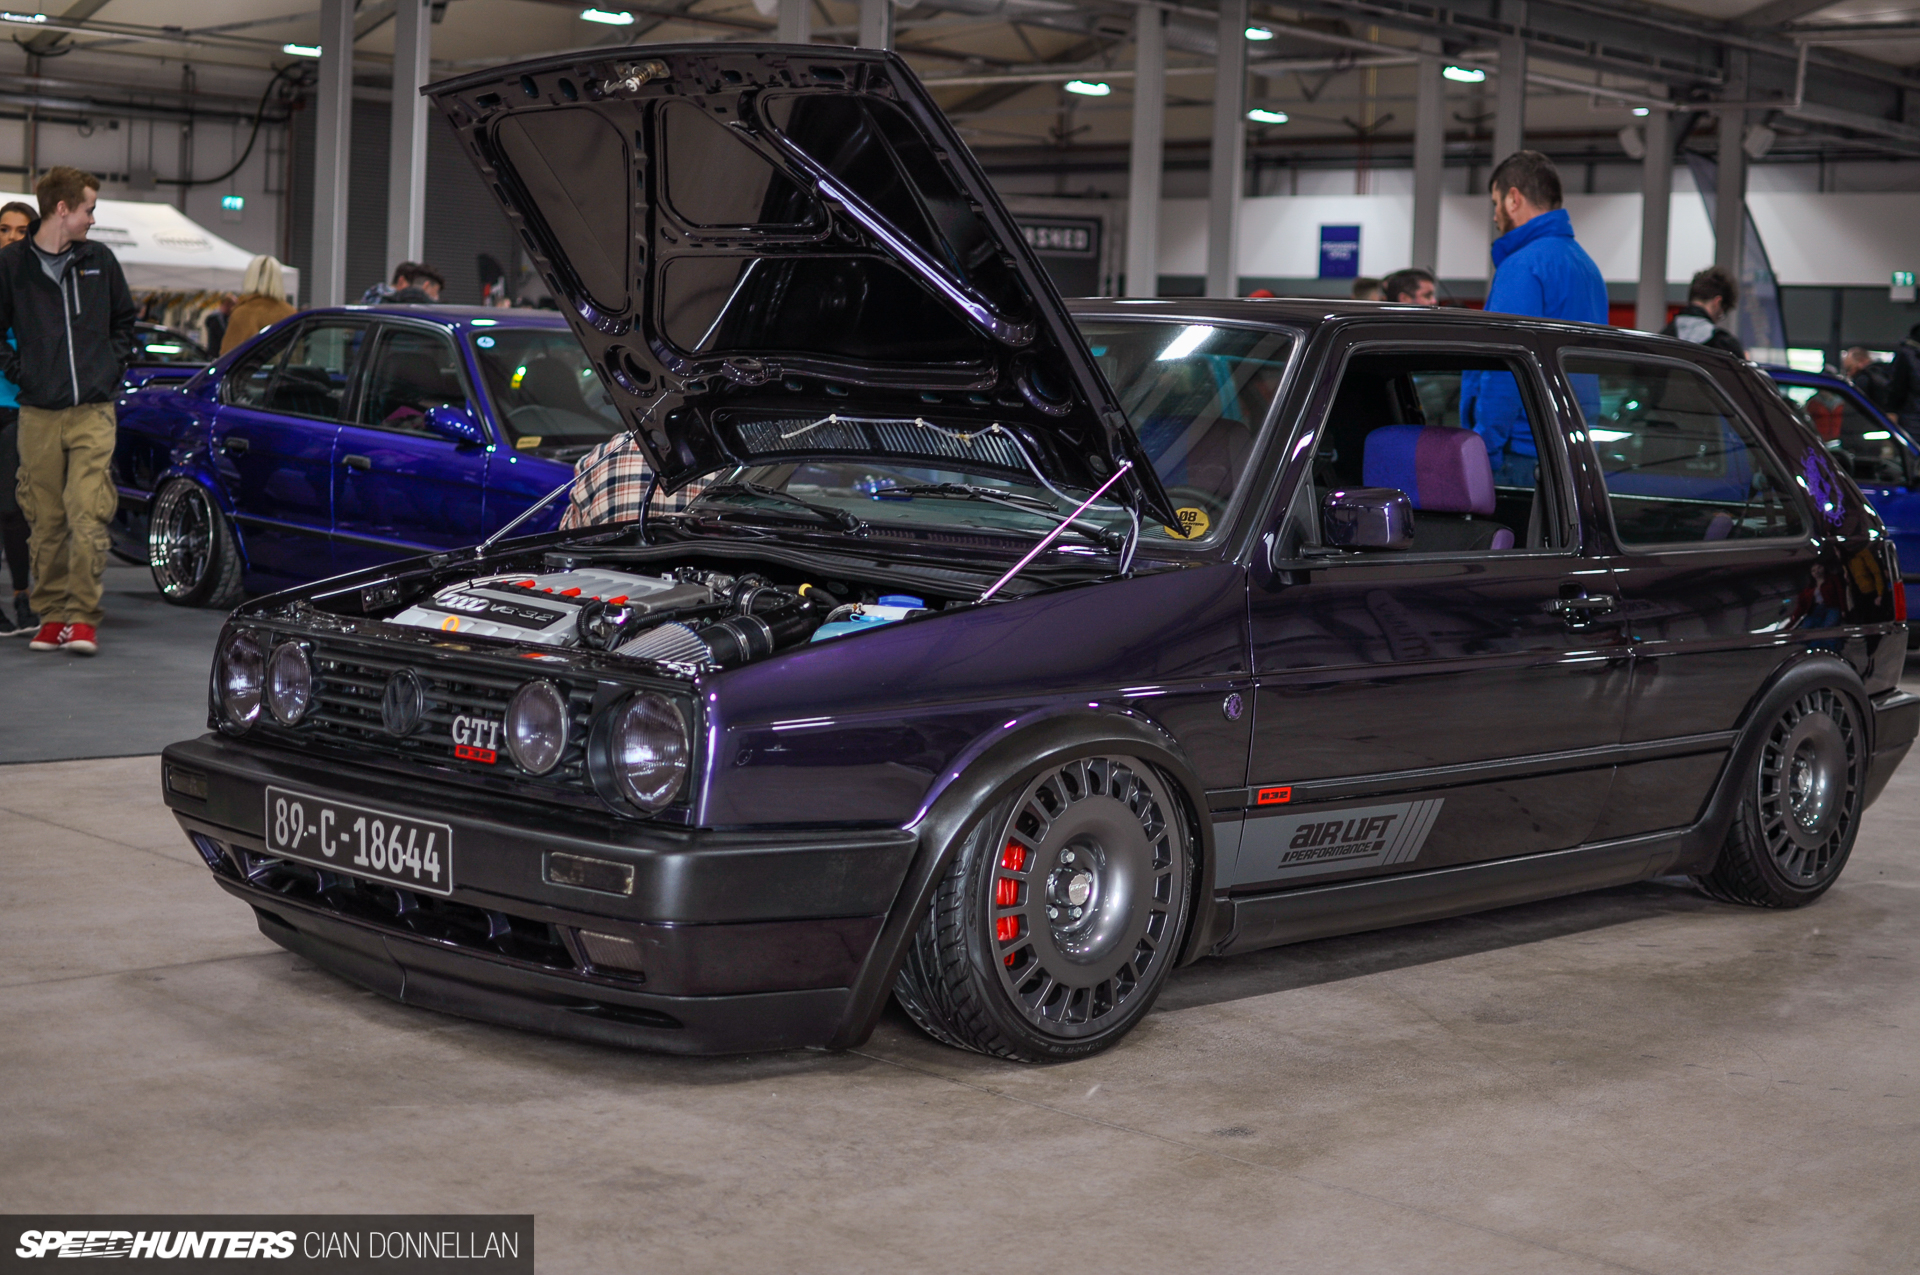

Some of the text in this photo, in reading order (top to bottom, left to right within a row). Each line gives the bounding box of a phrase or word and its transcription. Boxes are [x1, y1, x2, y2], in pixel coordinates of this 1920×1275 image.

[452, 715, 499, 750] GTI
[1260, 790, 1289, 801] R32
[275, 797, 441, 883] 89-C-18644
[1340, 814, 1398, 847] LIFT
[1289, 841, 1374, 863] PERFORMANCE
